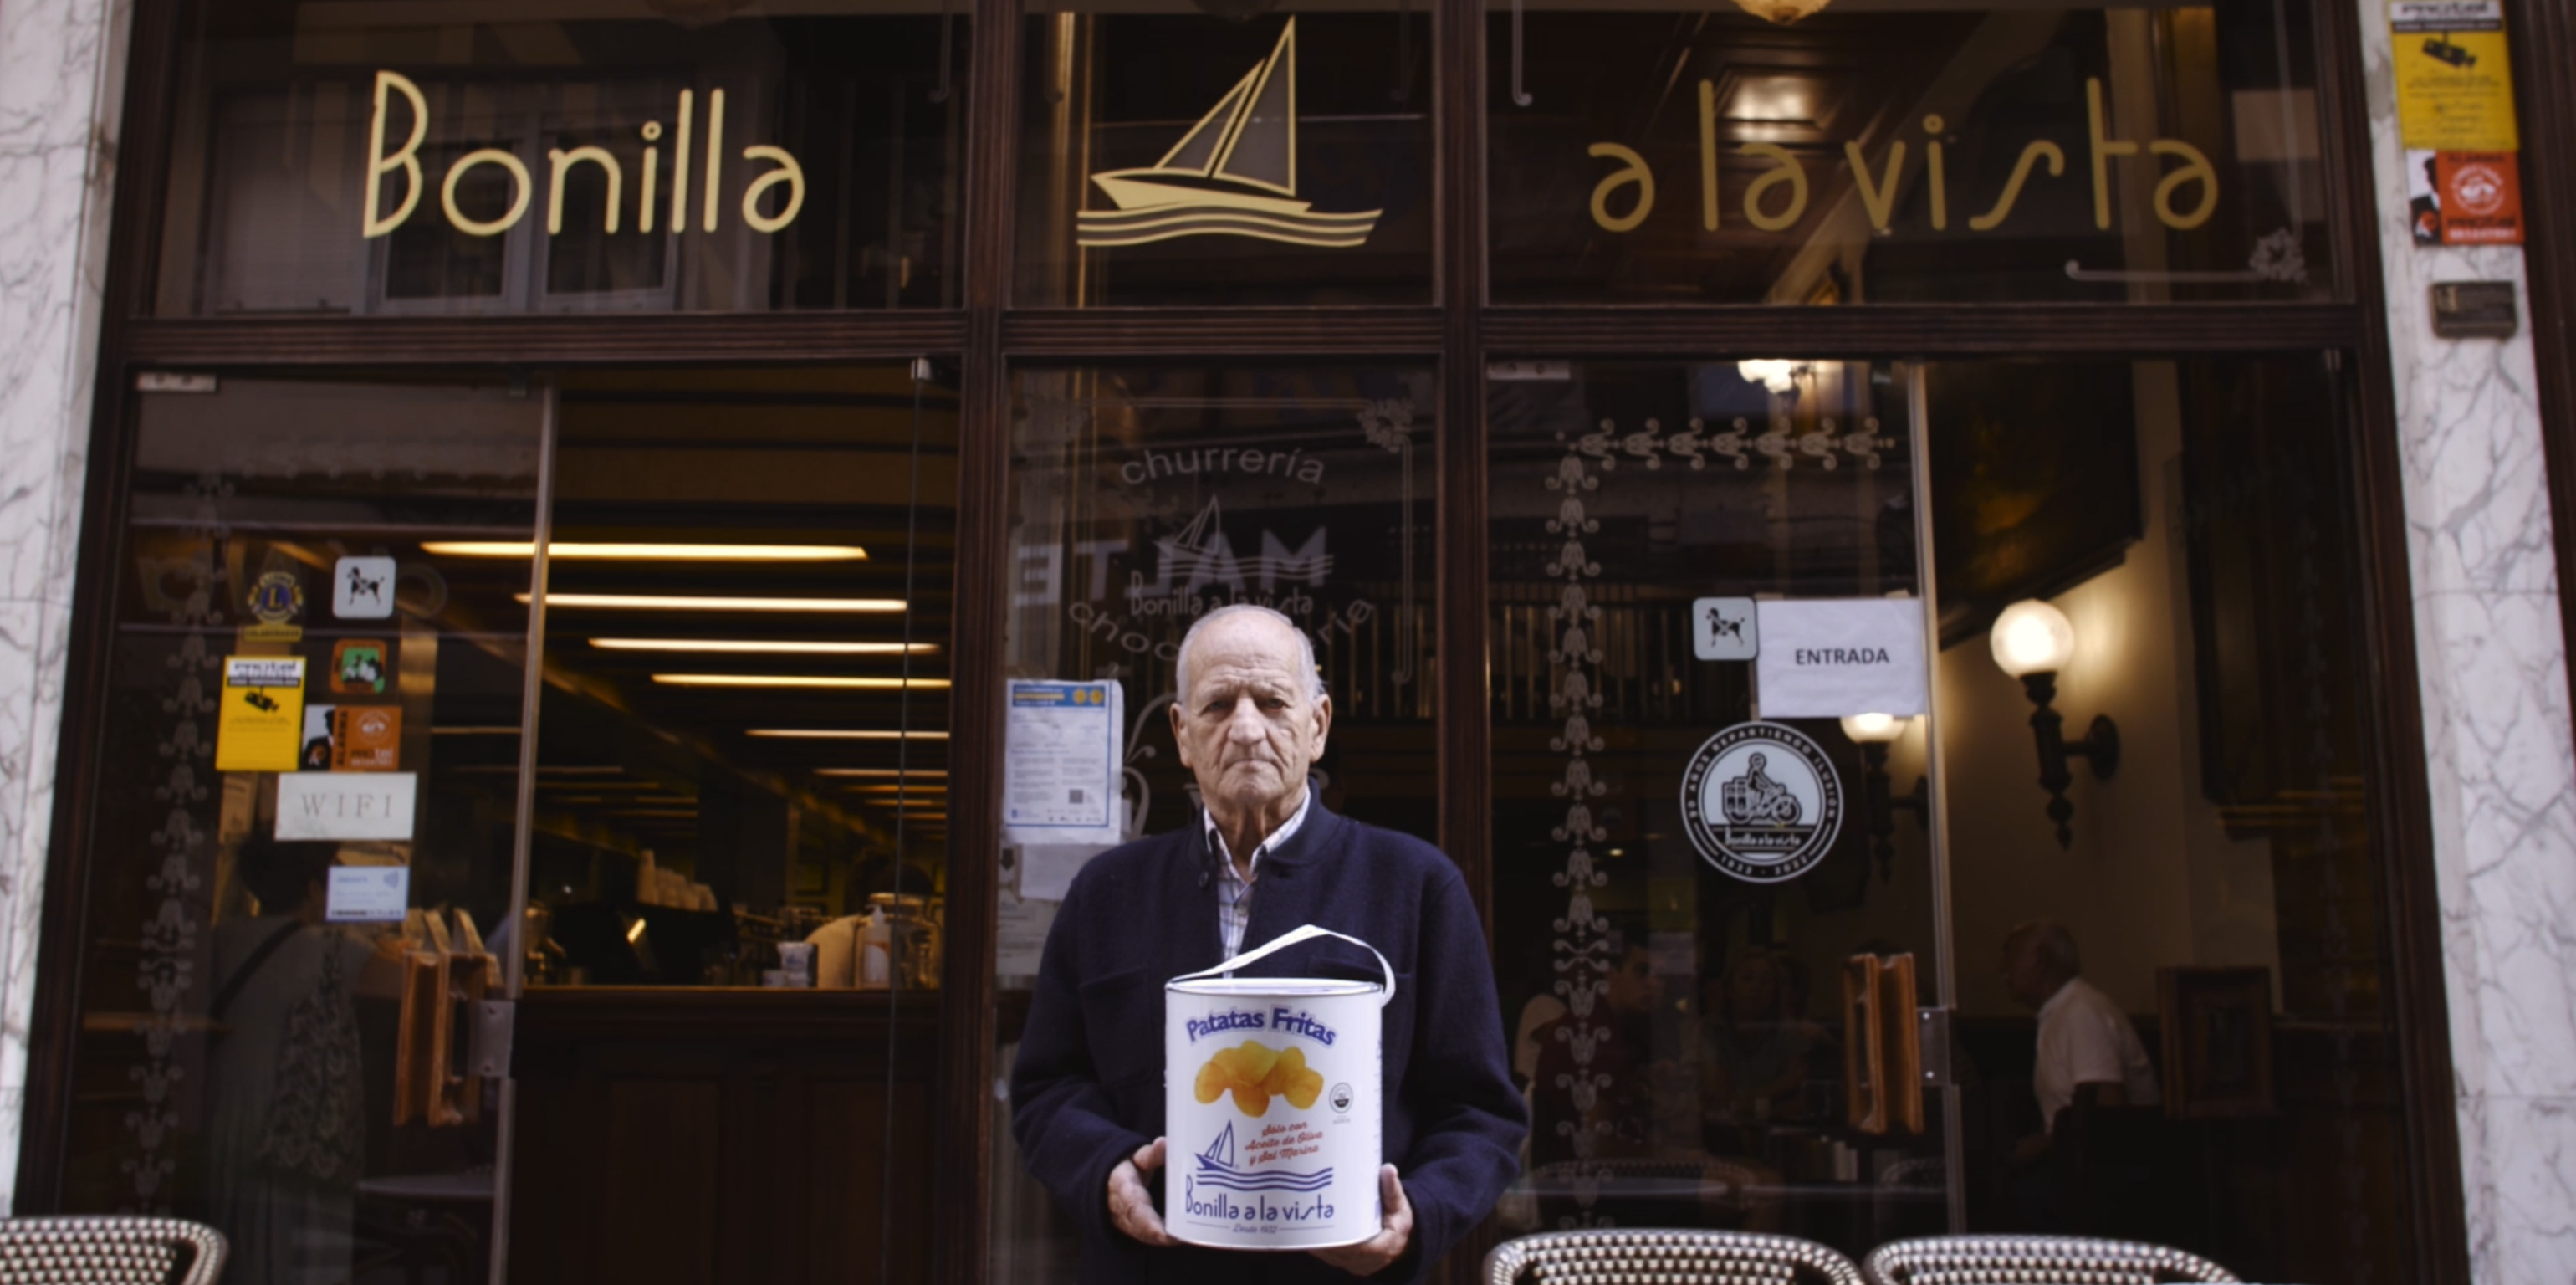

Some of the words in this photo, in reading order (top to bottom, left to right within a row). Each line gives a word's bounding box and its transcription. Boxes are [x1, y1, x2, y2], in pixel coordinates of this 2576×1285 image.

[363, 71, 805, 238] Bonilla
[1588, 141, 1655, 233] a
[1699, 79, 1809, 233] la
[1845, 77, 2219, 231] vista
[1121, 447, 1325, 485] churrería
[1130, 570, 1203, 617] Bonilla
[1795, 648, 1890, 666] ENTRADA
[1186, 1008, 1265, 1042] Patatas
[1270, 1006, 1337, 1047] Fritas
[1244, 1139, 1280, 1152] Aceite
[1281, 1134, 1295, 1146] de
[1296, 1130, 1324, 1144] Oliva
[1289, 1121, 1308, 1132] con
[1185, 1174, 1240, 1220] Bonilla
[1243, 1205, 1256, 1221] a
[1260, 1194, 1279, 1221] la
[1282, 1193, 1335, 1221] vista
